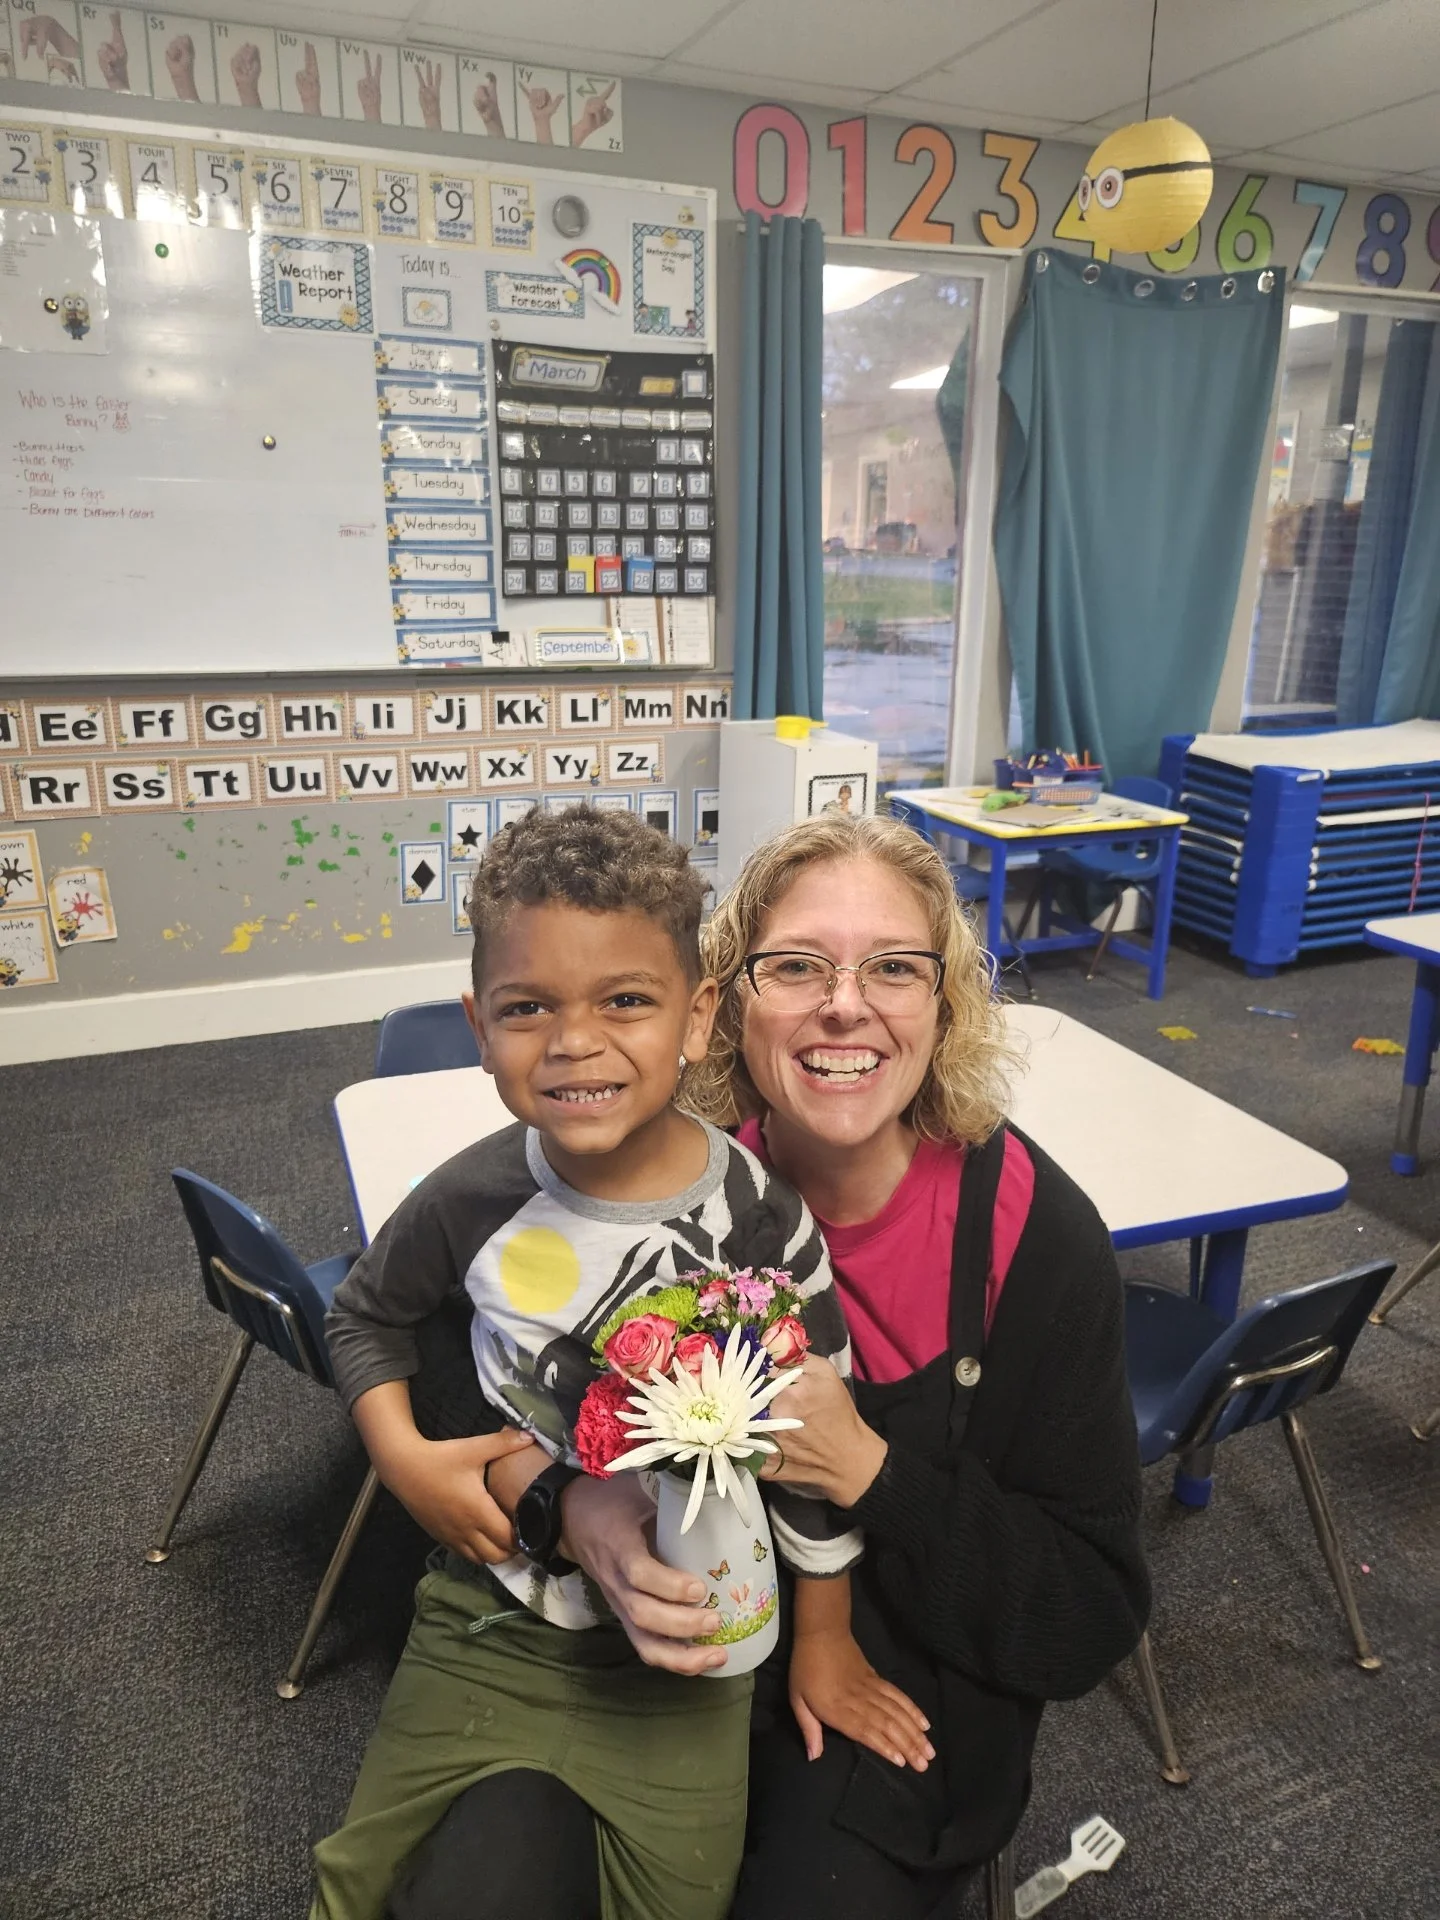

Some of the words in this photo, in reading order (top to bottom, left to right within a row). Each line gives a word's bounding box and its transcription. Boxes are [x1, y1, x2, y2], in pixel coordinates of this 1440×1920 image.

[83, 7, 97, 19] Rr
[150, 17, 165, 31] Ss
[216, 25, 229, 37] Tt
[280, 34, 297, 46] Uu
[343, 42, 360, 55] Vv
[403, 50, 426, 64] Ww
[462, 58, 478, 72] Xx
[518, 66, 533, 83] Yy
[6, 132, 30, 144] TWO
[69, 139, 101, 151] THREE
[608, 138, 621, 150] Zz
[10, 146, 30, 174] 2
[138, 147, 165, 158] FOUR
[207, 154, 226, 164] FIVE
[78, 149, 97, 185] 3
[140, 162, 162, 186] 4
[271, 161, 287, 171] SIX
[324, 168, 353, 178] SEVEN
[210, 164, 229, 197] 5
[270, 171, 291, 203] 6
[385, 174, 410, 185] EIGHT
[444, 180, 465, 191] NINE
[330, 177, 348, 209] 7
[389, 184, 408, 214] 8
[502, 187, 518, 197] TEN
[733, 103, 810, 223] 0
[828, 115, 867, 237] 1
[890, 124, 956, 244] 2
[979, 130, 1040, 248] 3
[1216, 175, 1274, 274] 6
[1294, 179, 1347, 281] 7
[1356, 193, 1410, 289] 8
[445, 190, 464, 221] 9
[498, 205, 521, 223] 10
[279, 263, 345, 282] Weather
[400, 254, 435, 279] Today
[298, 282, 353, 301] Report
[513, 282, 558, 297] Weather
[511, 295, 562, 310] Forecast
[529, 361, 587, 381] March
[408, 389, 458, 413] Sunday
[413, 473, 464, 495] Tuesday
[600, 477, 609, 492] 6
[661, 480, 670, 493] 8
[404, 514, 477, 538] Wednesday
[514, 542, 527, 555] 17
[539, 542, 553, 554] 18
[572, 543, 586, 555] 19
[412, 555, 472, 578] Thursday
[509, 576, 522, 588] 24
[569, 576, 583, 589] 26
[636, 575, 650, 586] 28
[660, 575, 674, 587] 29
[425, 594, 465, 616] Friday
[418, 636, 480, 655] Saturday
[372, 702, 394, 729] Ii
[434, 698, 466, 730] Jj
[496, 698, 544, 725] Kk
[570, 697, 598, 722] Ll
[624, 698, 671, 719] Mm
[686, 695, 727, 719] Nn
[40, 713, 98, 742] Ee
[133, 710, 174, 738] Ff
[205, 705, 262, 739] Gg
[283, 705, 338, 732] Hh
[412, 760, 467, 783] Ww
[487, 757, 525, 779] Xx
[554, 754, 589, 780] Yy
[616, 752, 649, 772] Zz
[112, 772, 166, 800] Ss
[194, 770, 240, 796] Tt
[268, 766, 322, 793] Uu
[343, 763, 392, 788] Vv
[29, 776, 80, 804] Rr
[67, 874, 87, 886] red
[1, 920, 34, 931] white
